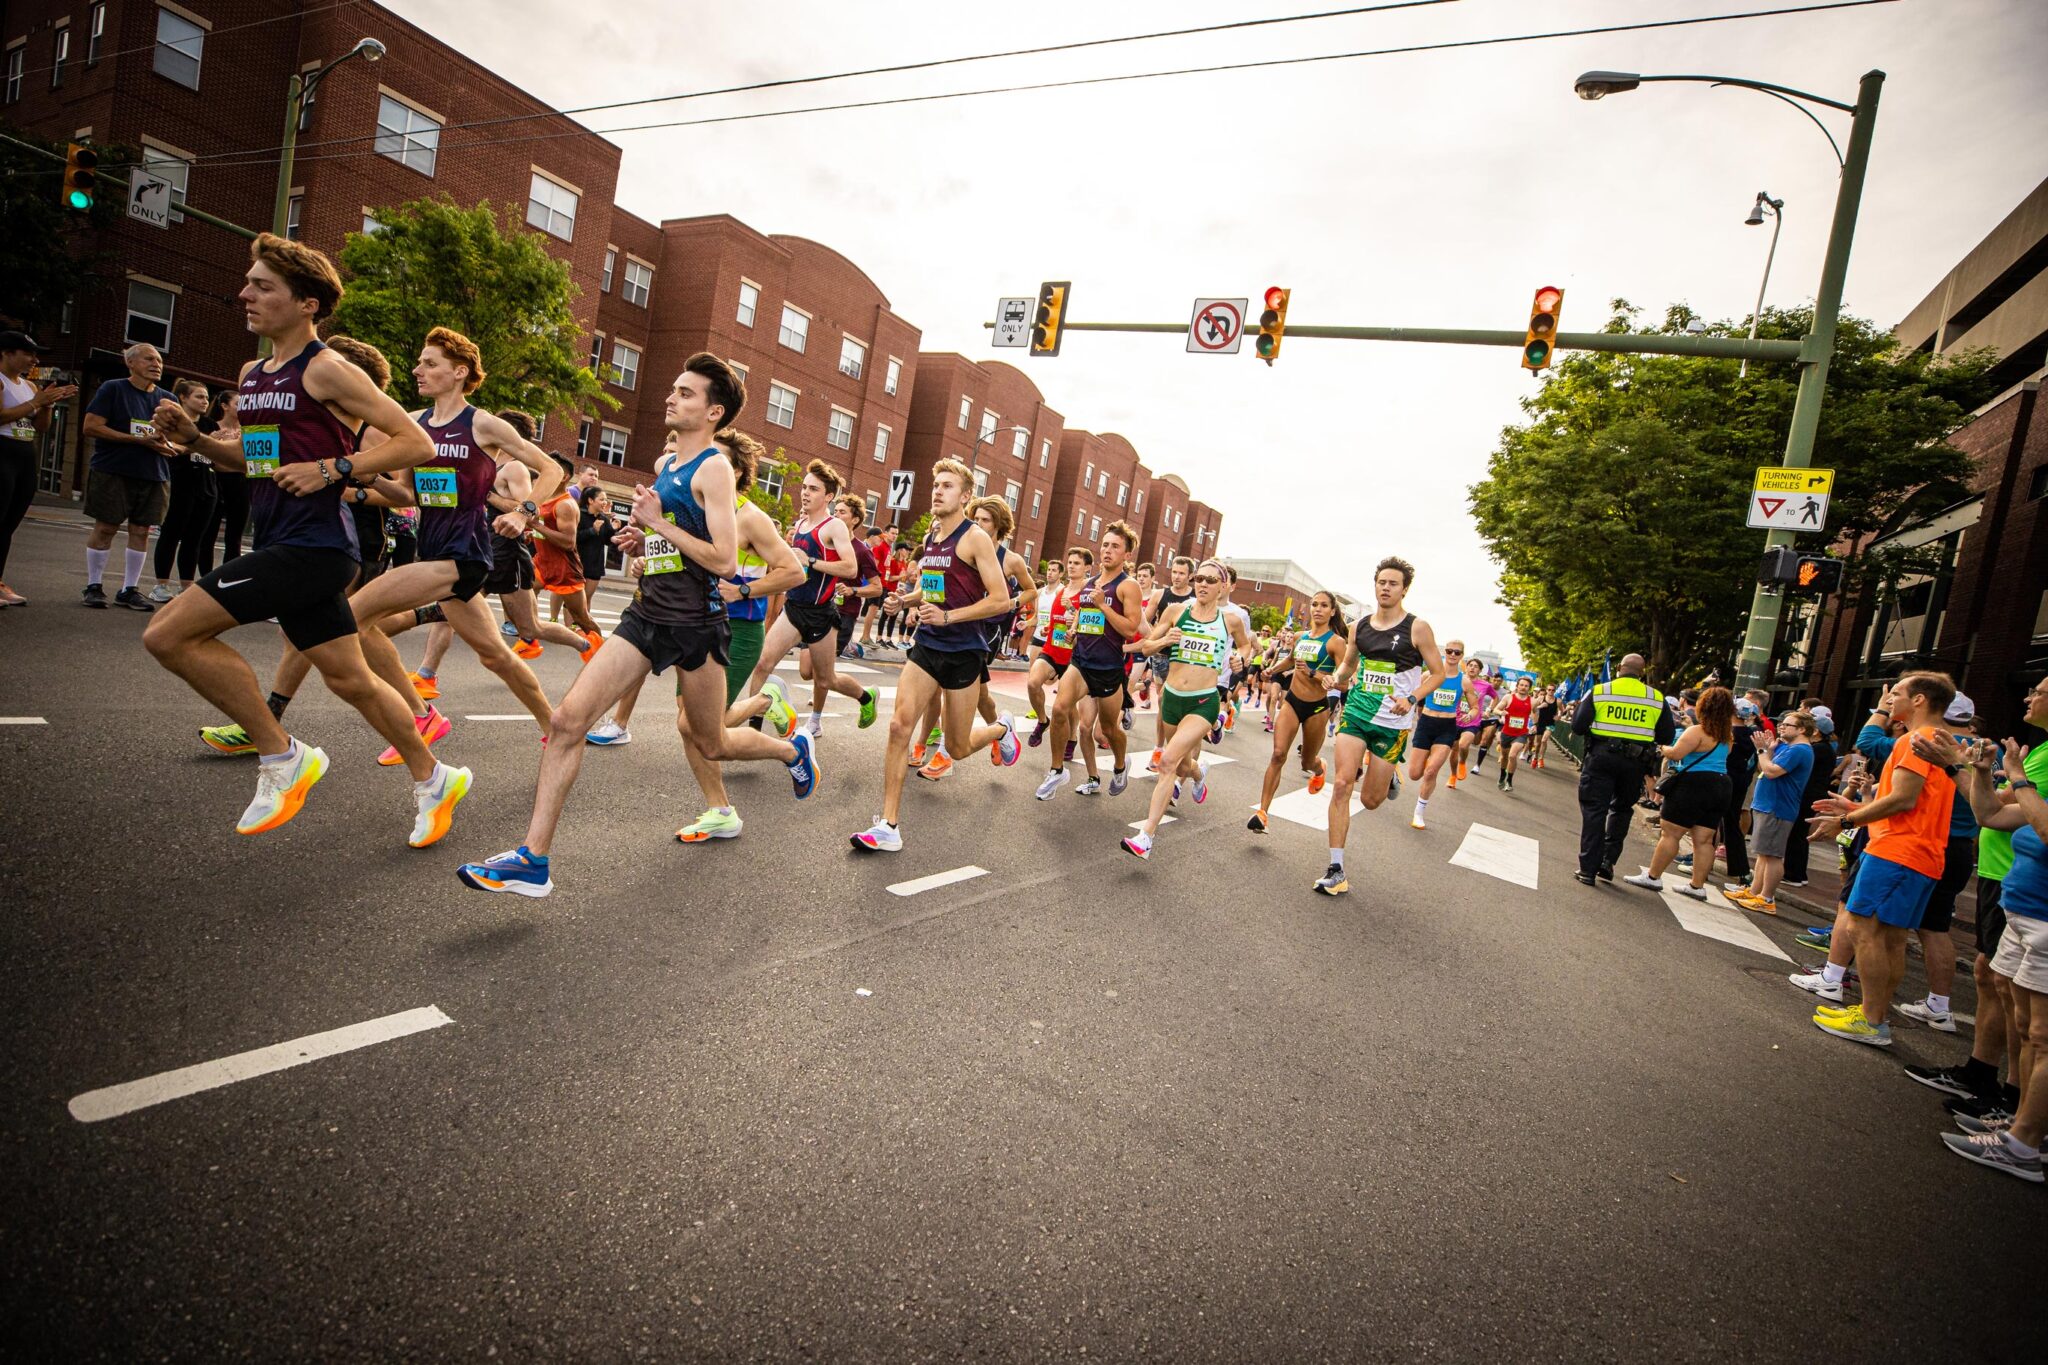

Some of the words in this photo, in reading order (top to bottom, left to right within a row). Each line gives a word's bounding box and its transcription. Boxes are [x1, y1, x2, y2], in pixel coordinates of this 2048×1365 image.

[131, 204, 165, 223] ONLY
[1001, 324, 1024, 333] ONLY
[245, 439, 273, 457] 2039
[1763, 471, 1803, 481] TURNING
[419, 478, 449, 491] 2037
[1762, 480, 1801, 490] VEHICLES
[1785, 508, 1796, 516] TO
[1081, 614, 1101, 625] 2042
[1183, 639, 1210, 653] 2072
[1364, 673, 1392, 685] 17261
[1606, 705, 1648, 723] POLICE
